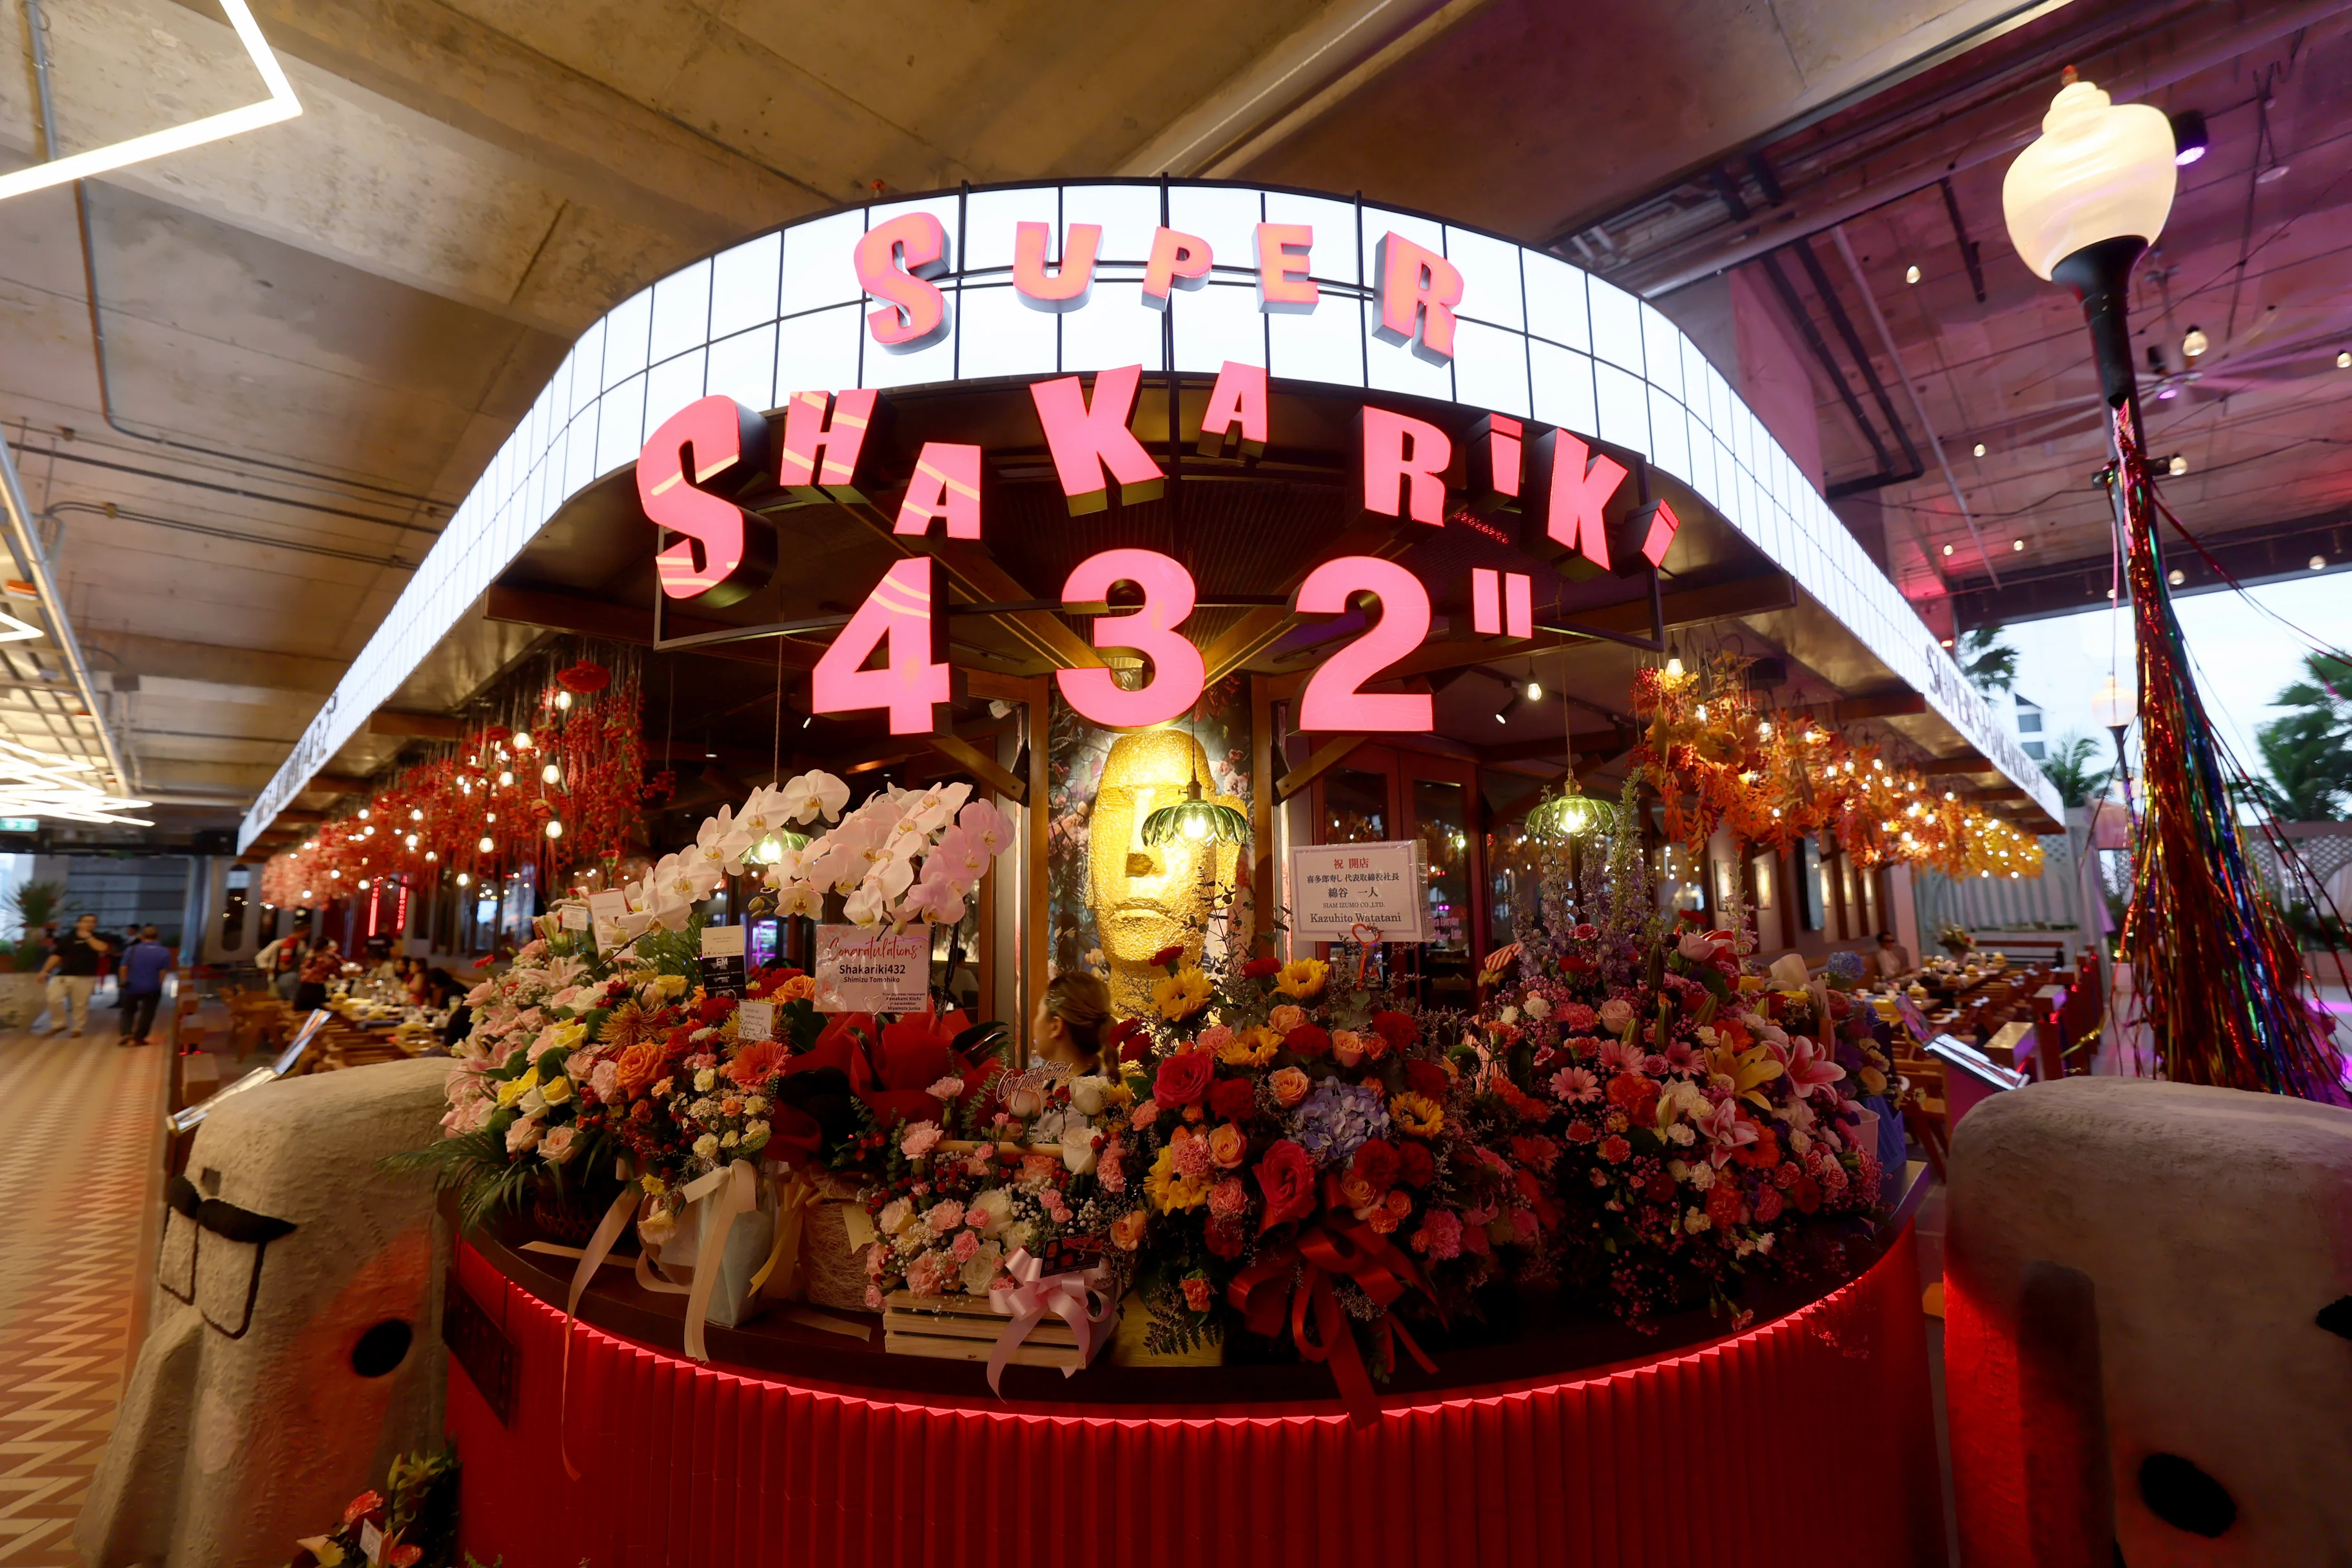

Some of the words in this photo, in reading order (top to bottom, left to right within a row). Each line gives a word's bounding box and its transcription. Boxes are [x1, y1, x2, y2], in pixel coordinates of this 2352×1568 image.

[853, 210, 1465, 365] SUPER
[1333, 858, 1344, 870] 祝
[1348, 857, 1369, 869] 開店
[1306, 874, 1343, 884] 喜多郎寿し
[1344, 872, 1400, 883] 代表取締役社長
[1328, 887, 1348, 899] 綿谷
[1357, 887, 1378, 897] 一人
[1309, 912, 1353, 923] Kazuhito
[1355, 912, 1402, 923] Watatani
[828, 936, 918, 962] Congratulations
[716, 957, 729, 966] EM
[839, 964, 906, 974] Shakariki432
[996, 1061, 1073, 1107] Congratulations
